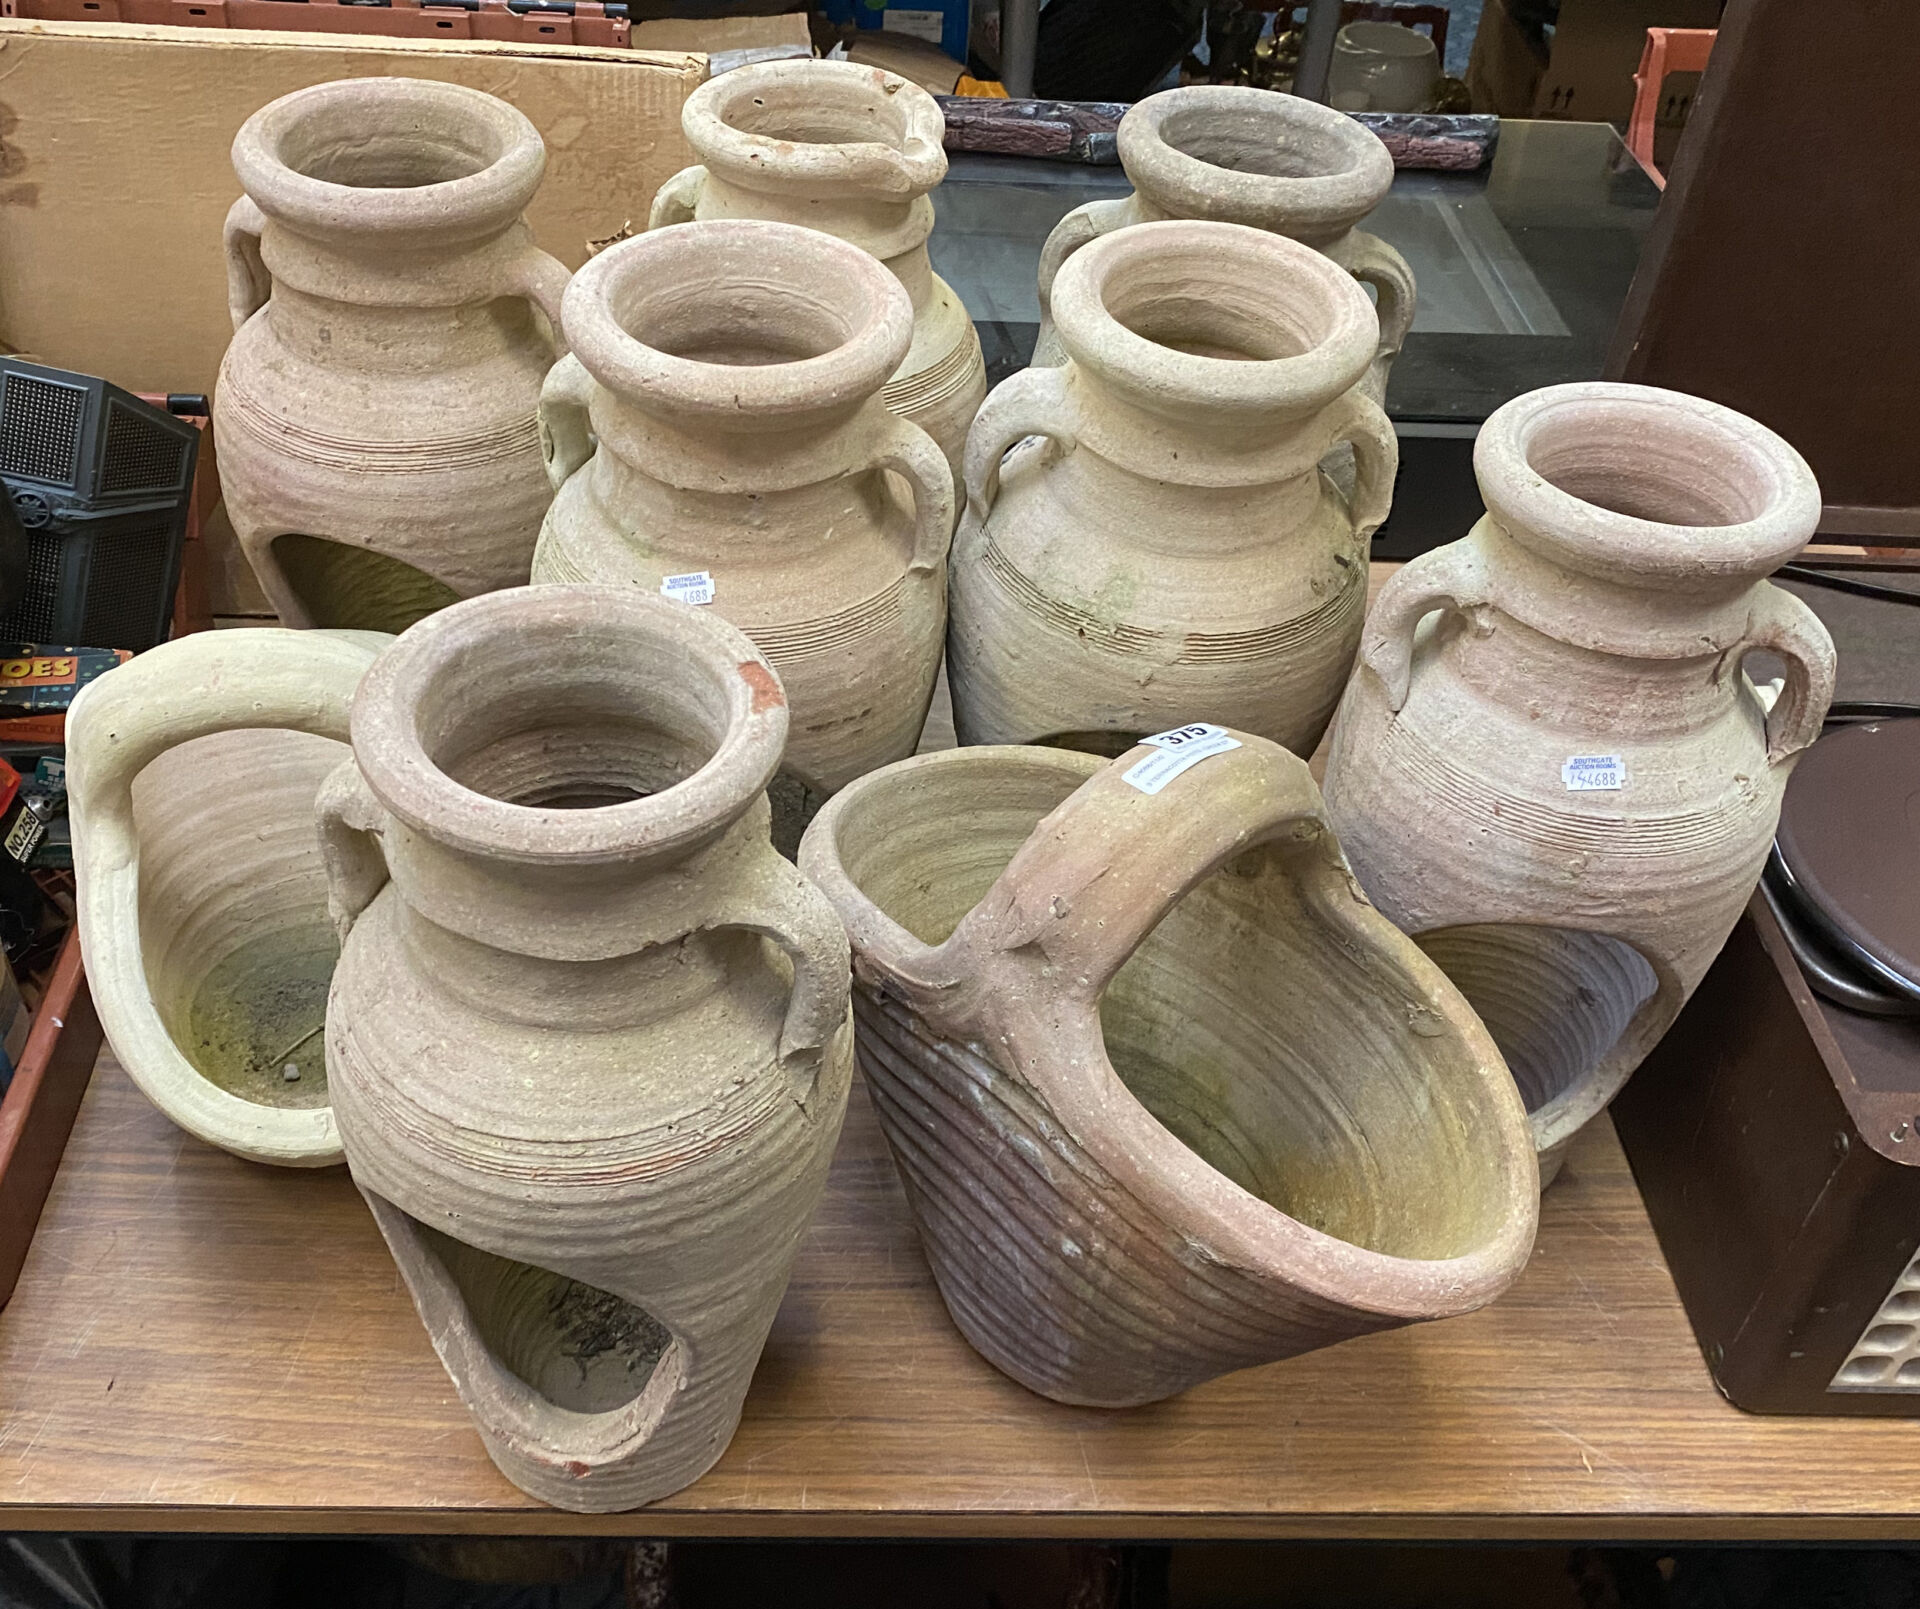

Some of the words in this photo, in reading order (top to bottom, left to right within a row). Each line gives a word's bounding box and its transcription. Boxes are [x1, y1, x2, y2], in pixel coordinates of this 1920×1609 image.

[669, 575, 703, 584] SOUTHGATE
[1159, 726, 1208, 745] 375
[1573, 757, 1613, 765] SOUTHGATE
[8, 811, 36, 856] NO.258
[20, 843, 34, 864] SUPER
[32, 824, 45, 846] POWER
